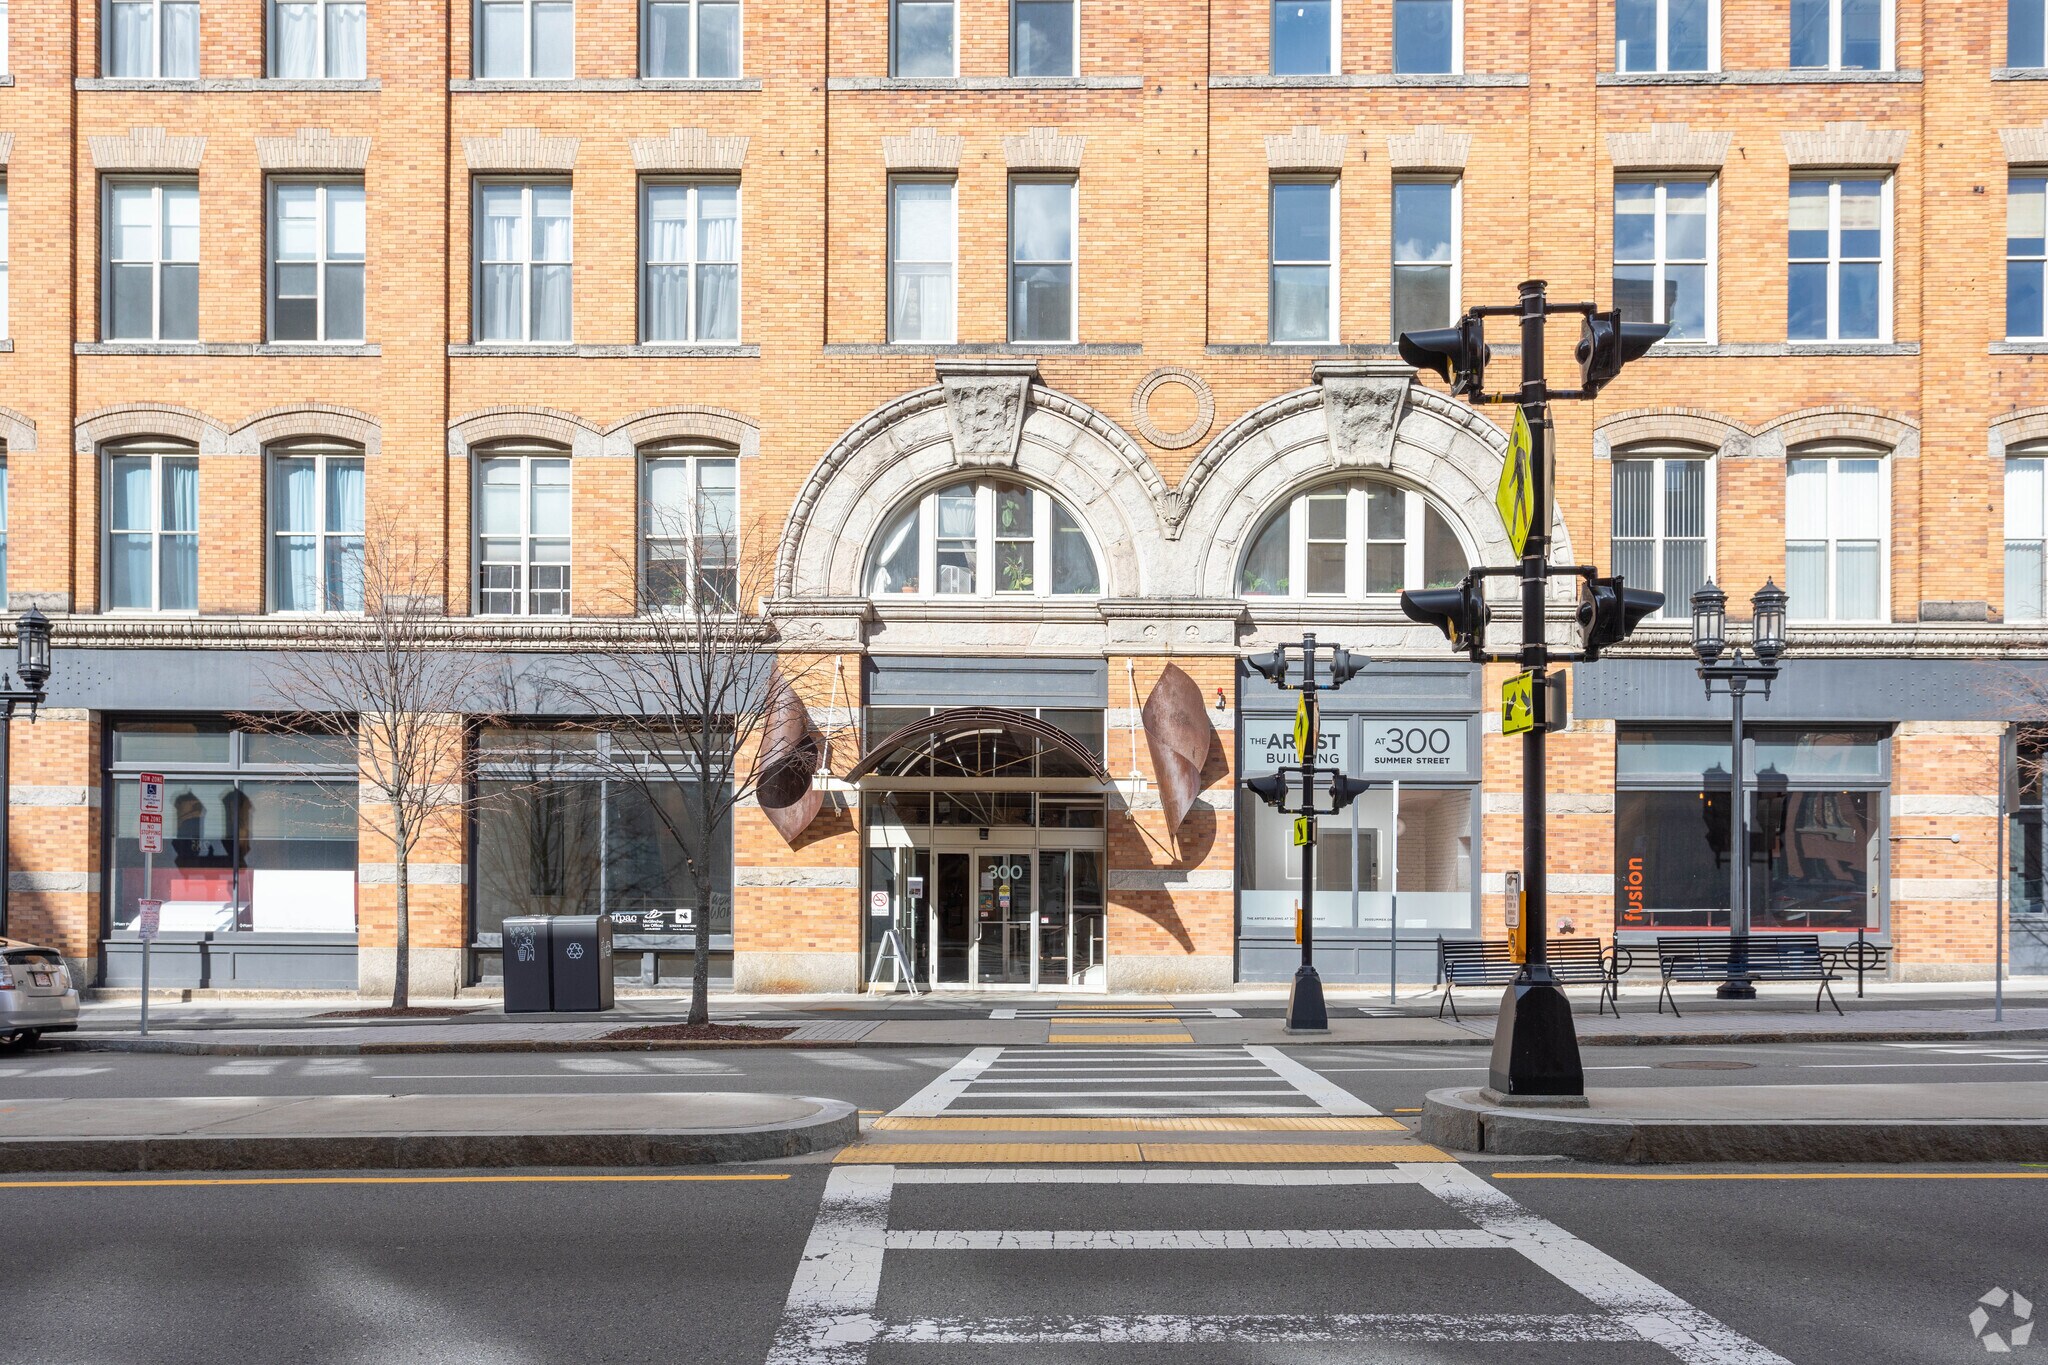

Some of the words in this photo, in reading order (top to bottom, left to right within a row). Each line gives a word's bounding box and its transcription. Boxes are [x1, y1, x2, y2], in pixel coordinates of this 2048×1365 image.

[1266, 733, 1341, 750] ARST
[1386, 728, 1450, 754] 300
[1266, 753, 1340, 764] BUILNG
[988, 865, 1023, 880] 300
[1624, 857, 1643, 922] fusion
